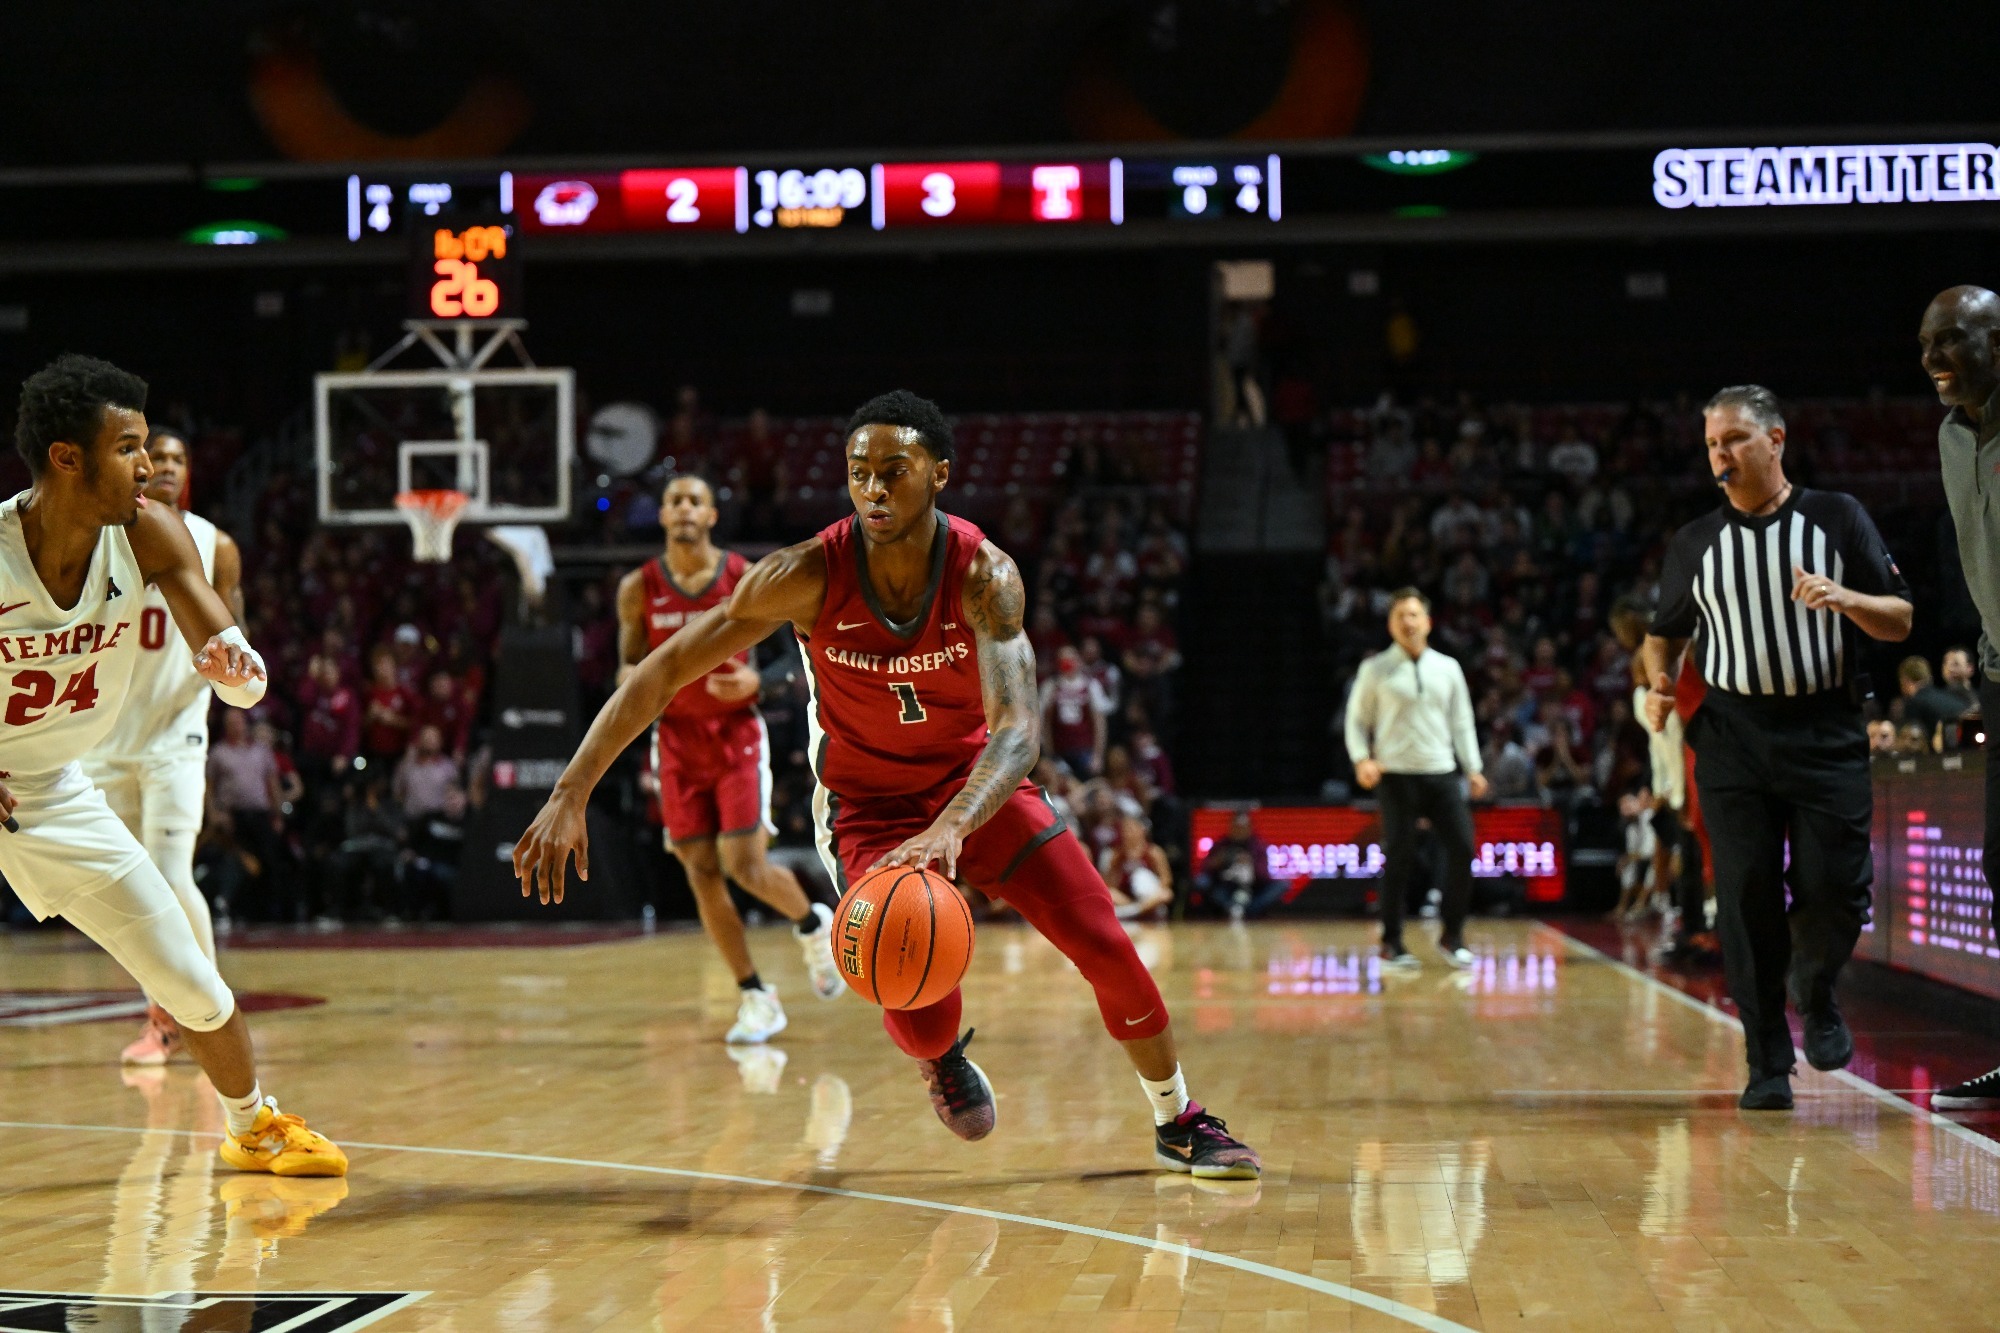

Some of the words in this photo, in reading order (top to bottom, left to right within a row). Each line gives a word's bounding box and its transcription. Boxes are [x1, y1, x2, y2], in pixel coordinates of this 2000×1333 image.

[755, 168, 866, 209] 16:09
[921, 172, 956, 217] 3
[1655, 145, 2000, 205] STEAMFITTER
[666, 178, 700, 223] 2
[431, 258, 499, 317] 26
[0, 622, 130, 663] TEMPLE
[140, 608, 166, 650] 0
[825, 646, 883, 673] SAINT
[887, 642, 969, 675] JOSEPH'S
[5, 661, 99, 726] 24
[888, 682, 927, 724] 1
[843, 899, 871, 977] ELITE
